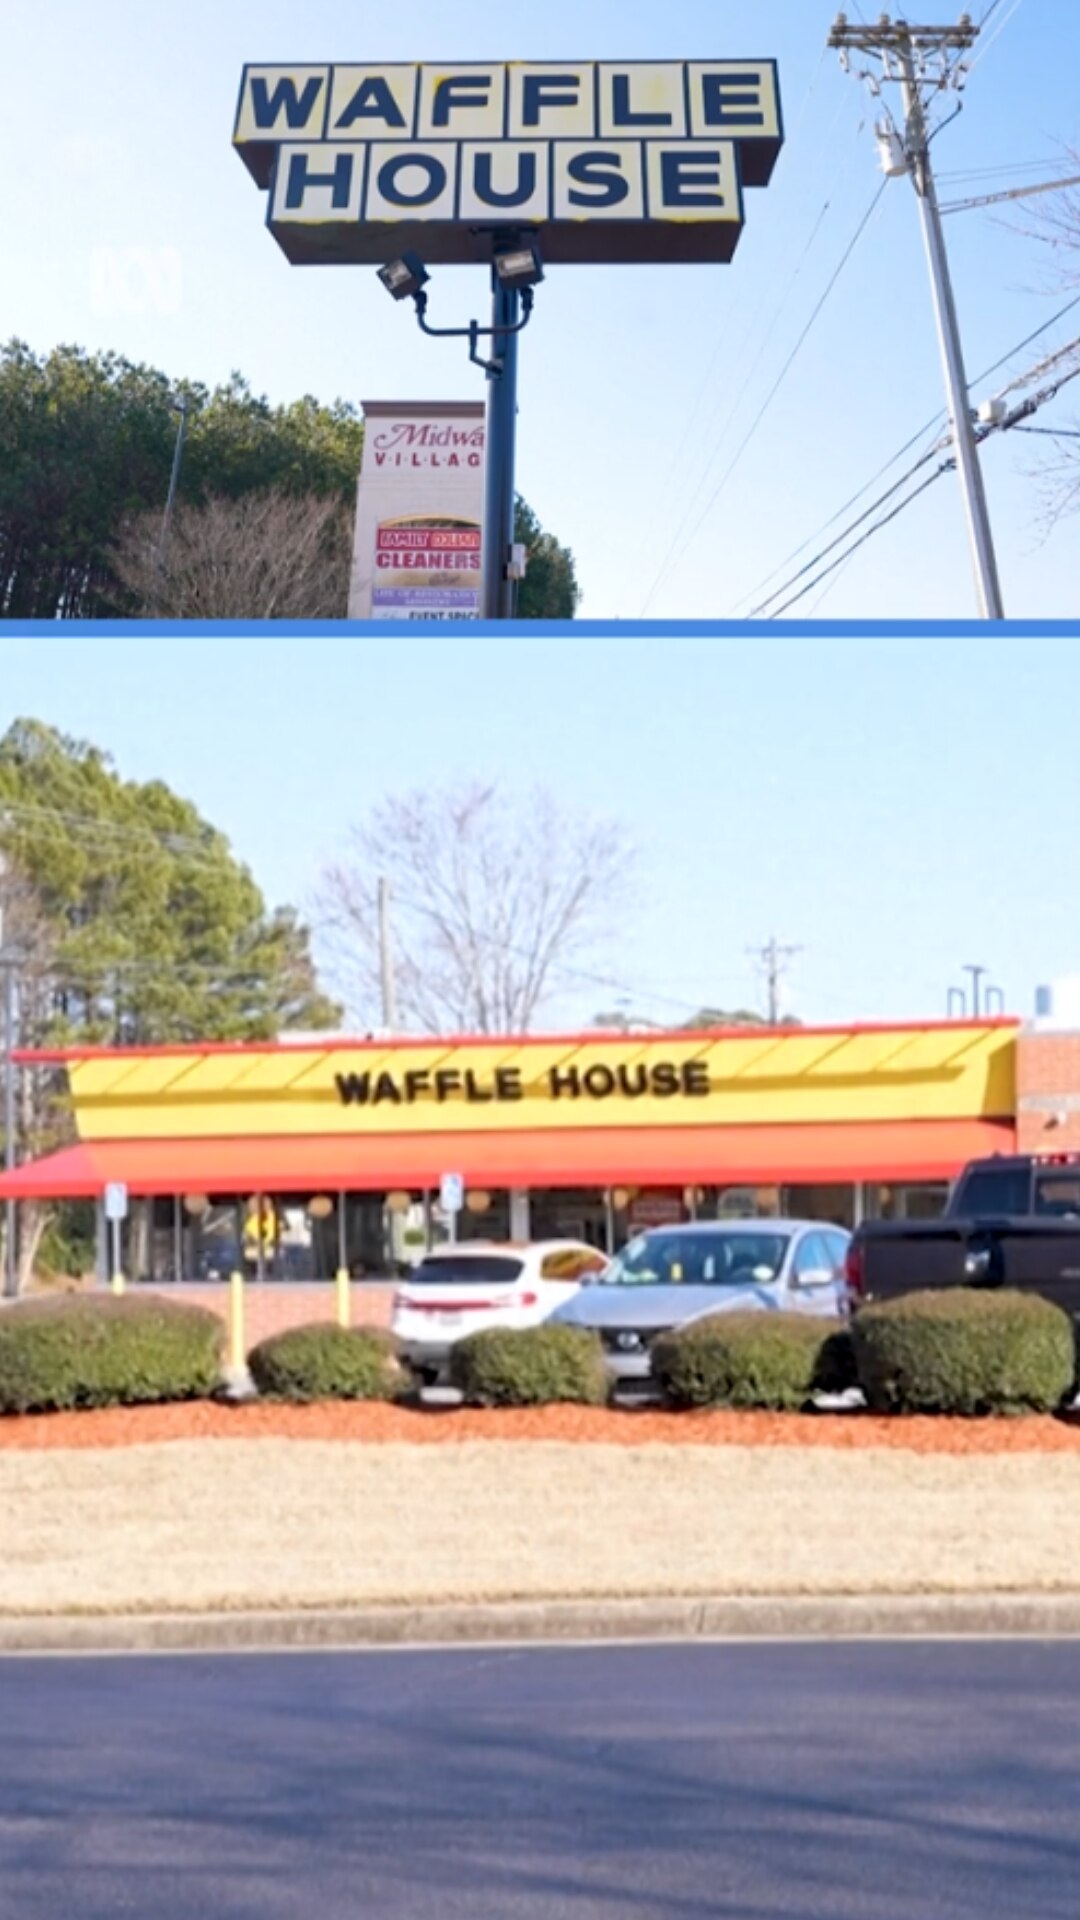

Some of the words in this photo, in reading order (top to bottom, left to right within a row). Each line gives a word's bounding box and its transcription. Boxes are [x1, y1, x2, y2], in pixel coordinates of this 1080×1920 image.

[248, 73, 766, 129] WAFFLE
[284, 150, 726, 209] HOUSE
[373, 423, 485, 451] Midwa
[376, 553, 481, 570] CLEANERS
[335, 1067, 524, 1106] WAFFLE
[549, 1061, 711, 1100] HOUSE
